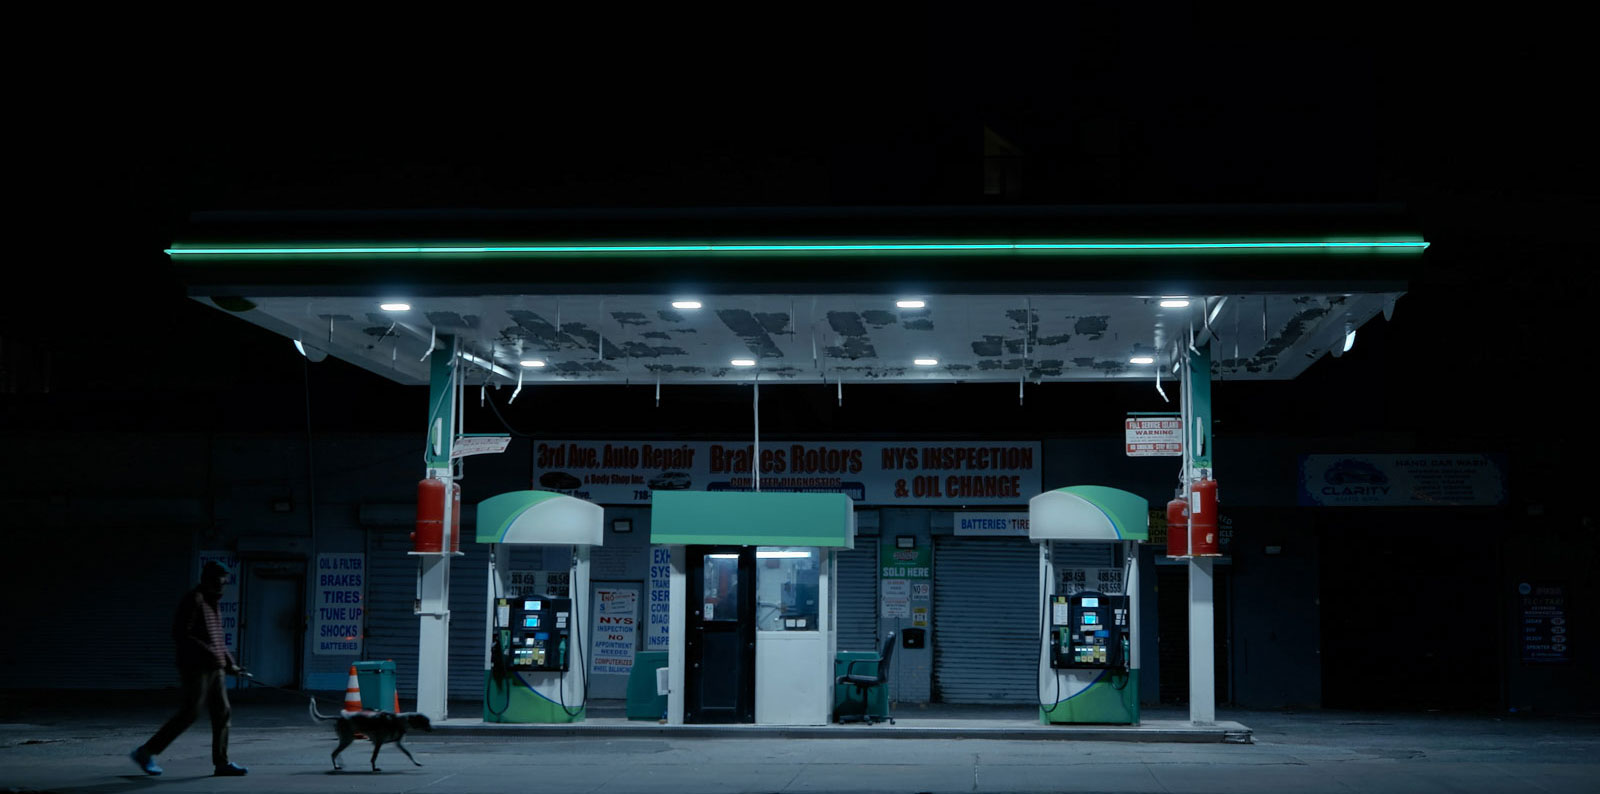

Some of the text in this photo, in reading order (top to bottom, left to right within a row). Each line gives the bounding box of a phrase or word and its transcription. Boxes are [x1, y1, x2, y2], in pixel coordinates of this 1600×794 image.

[537, 443, 566, 469] 3rd
[602, 444, 639, 469] Auto
[641, 444, 696, 471] Repair
[790, 444, 863, 474] Rotors
[881, 447, 1033, 470] NYS INSPECTION
[591, 474, 610, 486] Body
[611, 474, 630, 486] Shop
[894, 476, 1021, 498] & OIL CHANGE
[1321, 486, 1391, 496] CLARITY
[961, 518, 1007, 530] BATTERIES
[319, 558, 362, 570] OIL & FILTER
[651, 566, 670, 578] SYS
[883, 567, 930, 578] SOLD HERE
[320, 574, 362, 586] BRAKES
[323, 591, 360, 604] TIRES
[651, 590, 670, 602] SER
[320, 607, 362, 621] TUNE UP
[600, 617, 633, 625] NYS
[320, 625, 358, 637] SHOCKS
[597, 625, 633, 633] INSPECTION
[320, 642, 358, 650] BATTERIES
[595, 641, 633, 649] APPOINTMENT
